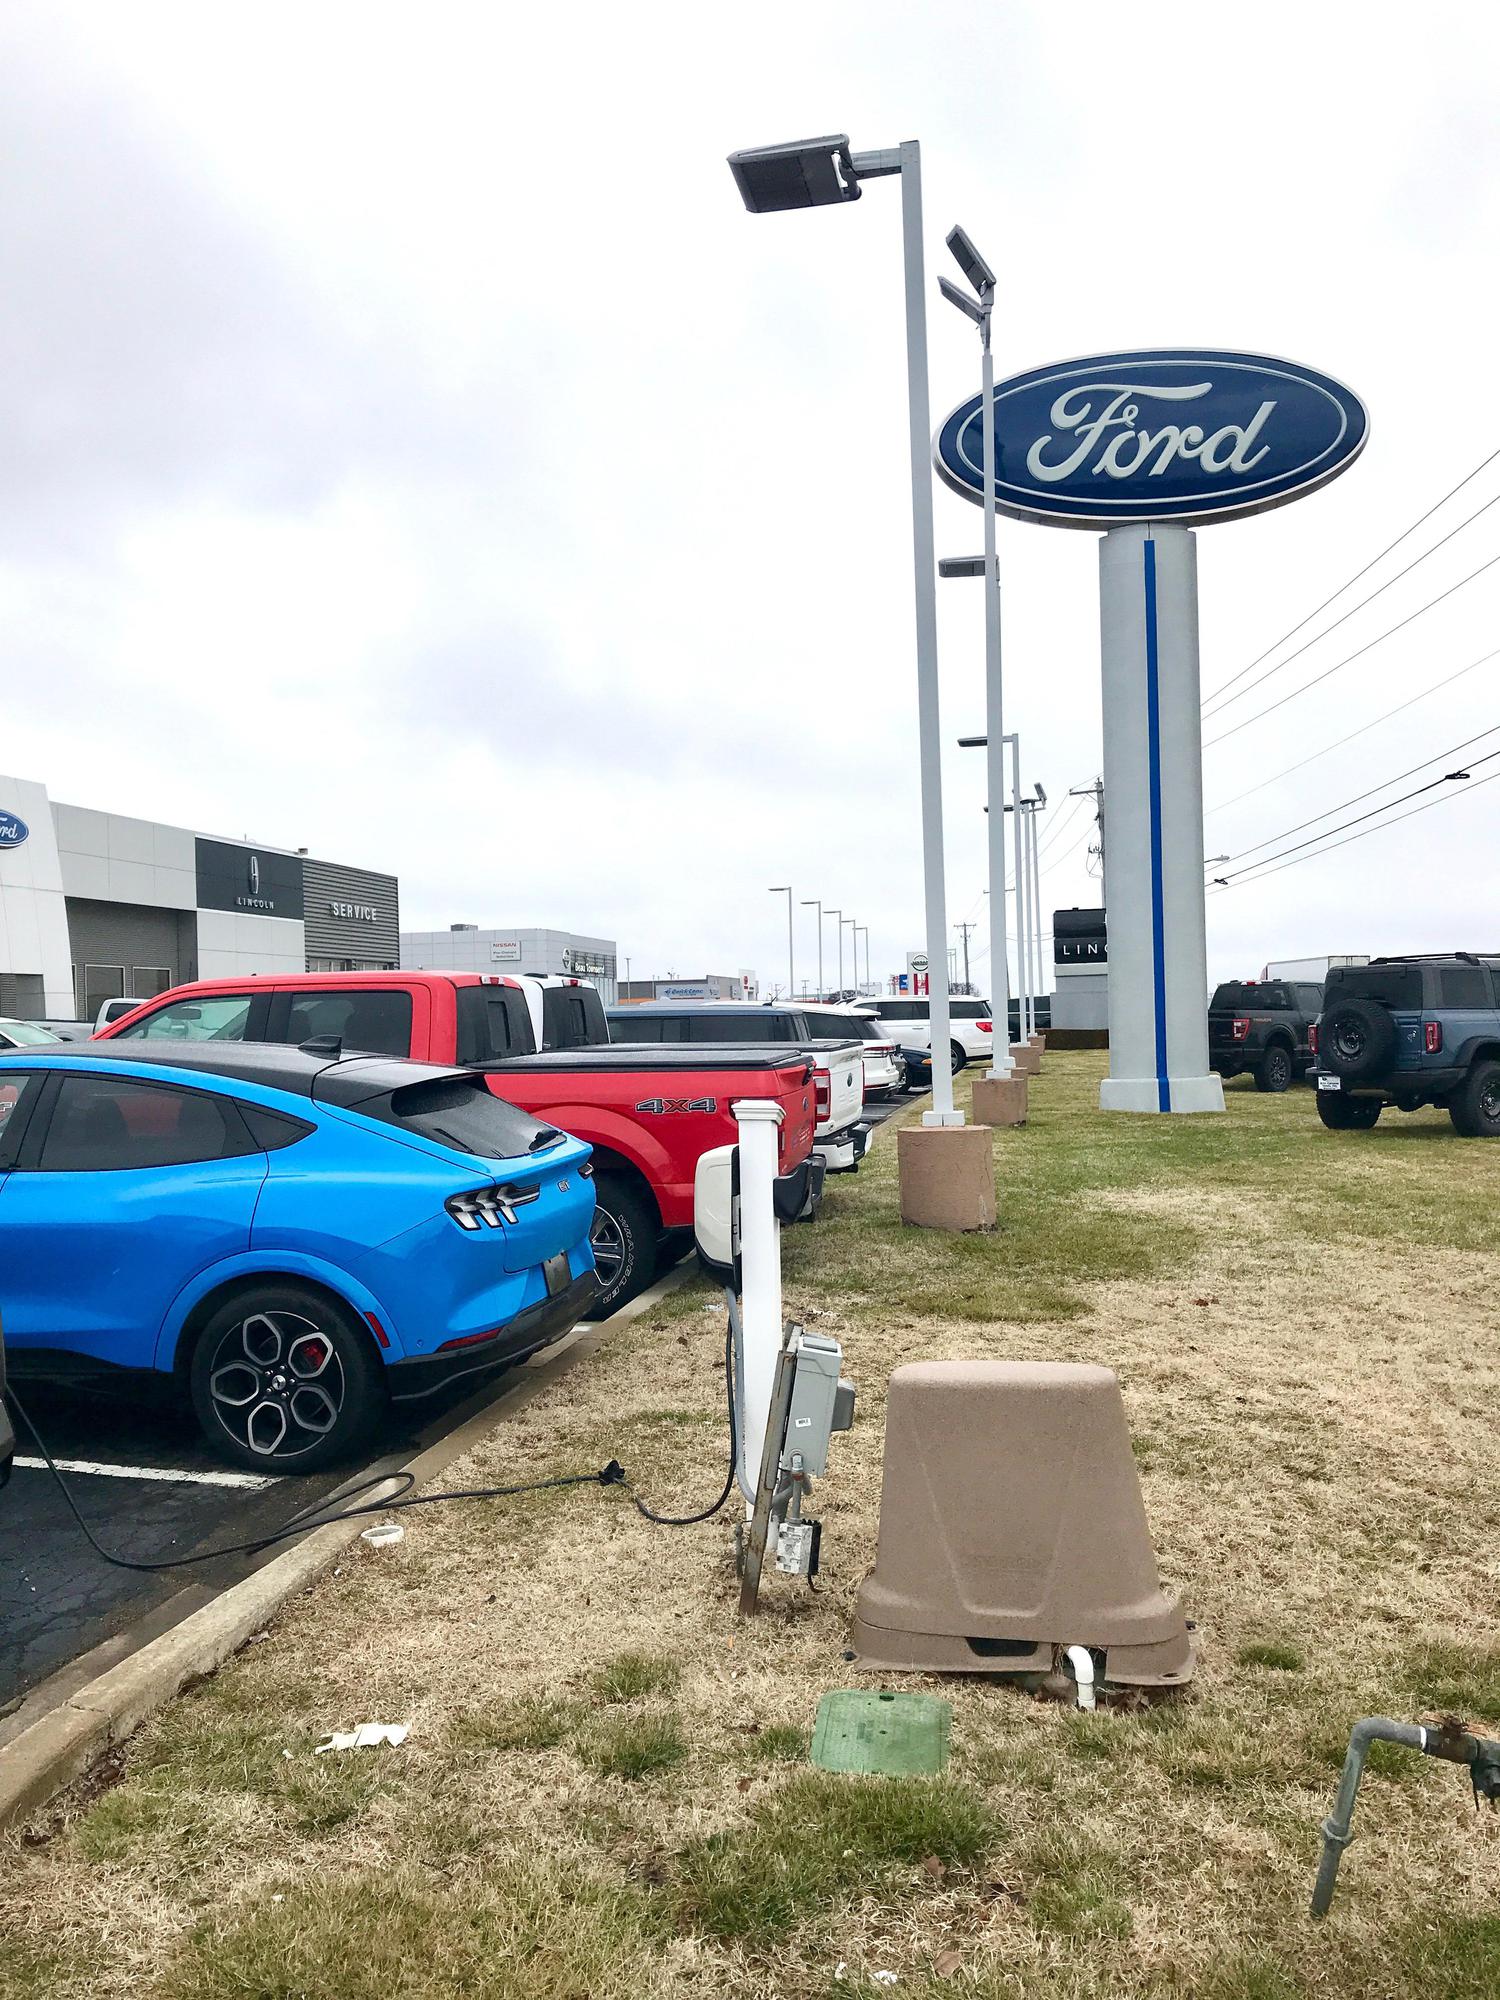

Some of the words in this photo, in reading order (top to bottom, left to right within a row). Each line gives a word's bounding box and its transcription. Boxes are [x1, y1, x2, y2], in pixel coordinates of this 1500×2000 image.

[1027, 382, 1277, 482] Ford
[0, 818, 17, 838] rd
[238, 897, 274, 909] LINCOLN
[333, 902, 377, 921] SERVICE
[602, 1214, 634, 1304] WRANGLER
